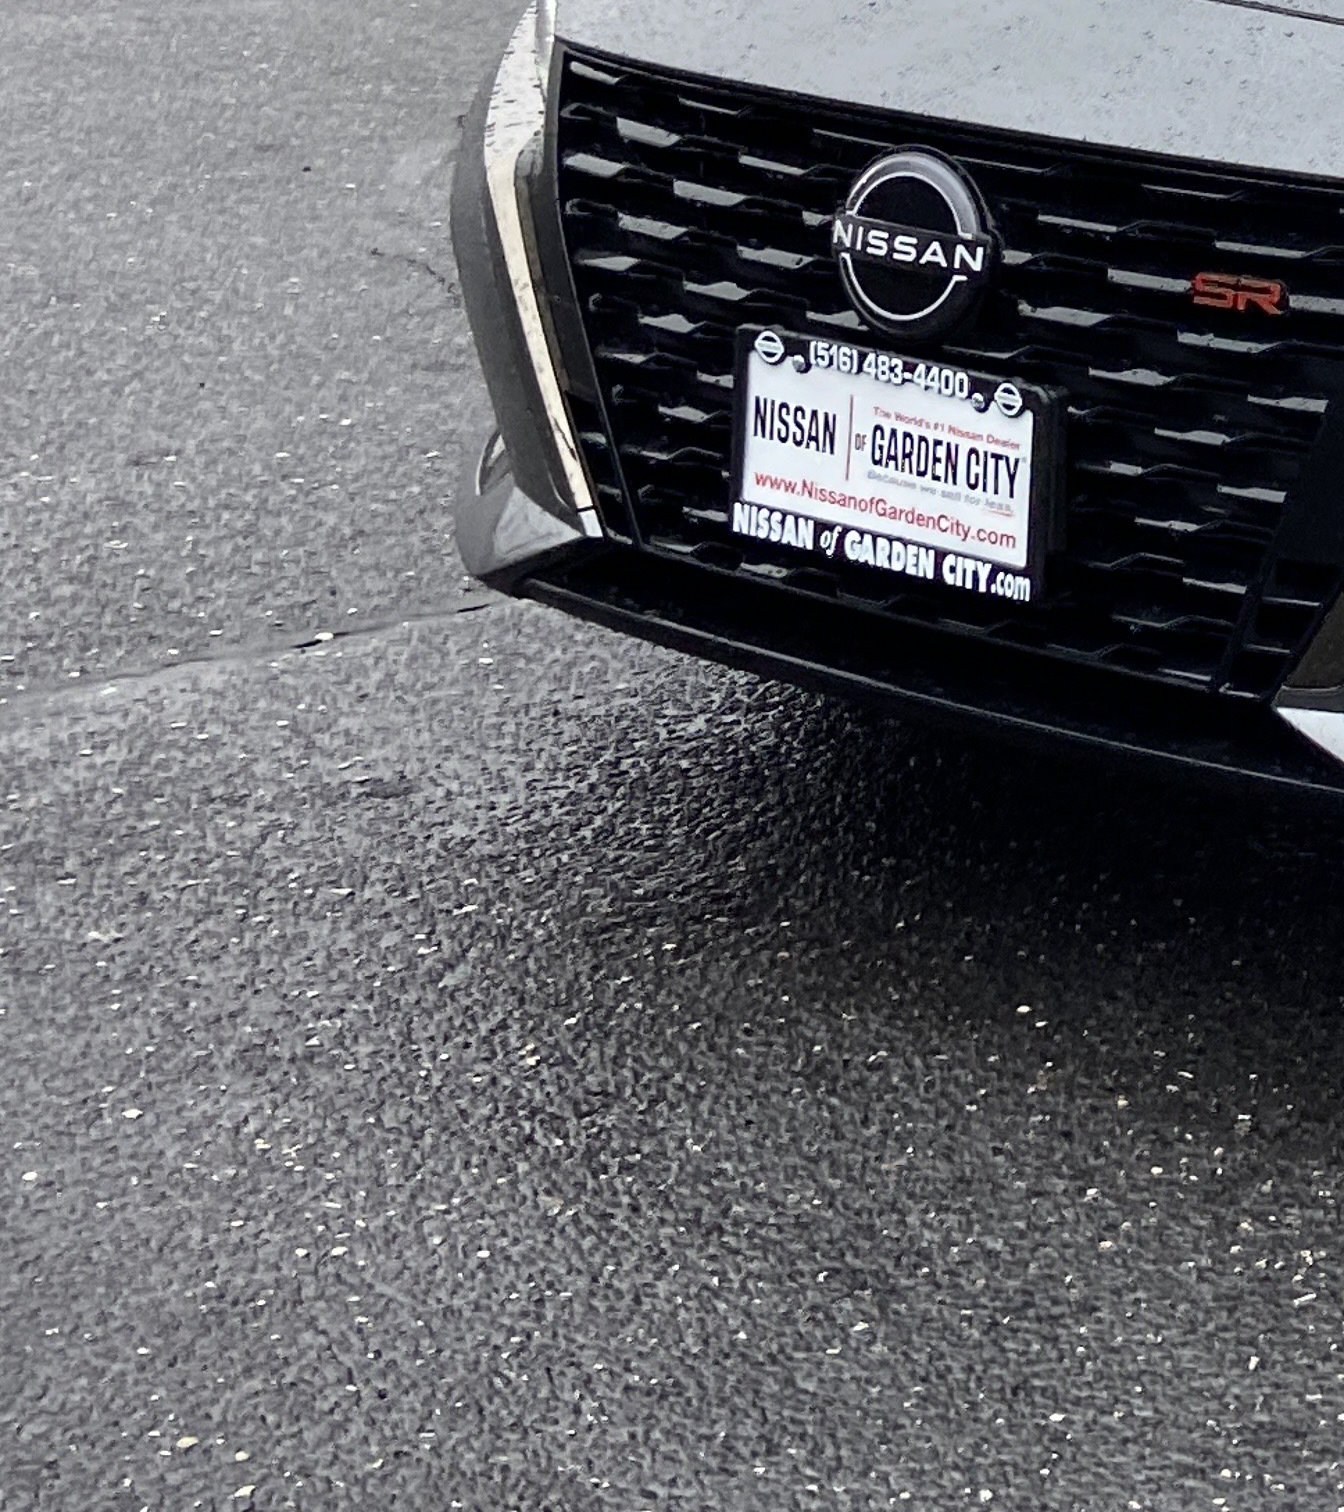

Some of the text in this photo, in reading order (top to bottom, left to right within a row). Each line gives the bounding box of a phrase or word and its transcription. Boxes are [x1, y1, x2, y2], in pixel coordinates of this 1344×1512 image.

[832, 219, 984, 272] NISSAN
[1192, 272, 1283, 315] SR
[809, 341, 970, 401] (516) 483-4400
[753, 395, 1020, 499] NISSAN OF GARDEN CITY
[754, 471, 1017, 549] www.NissanofGardenCity.com
[732, 502, 1031, 602] NISSAN of GARDEN CITY.com
